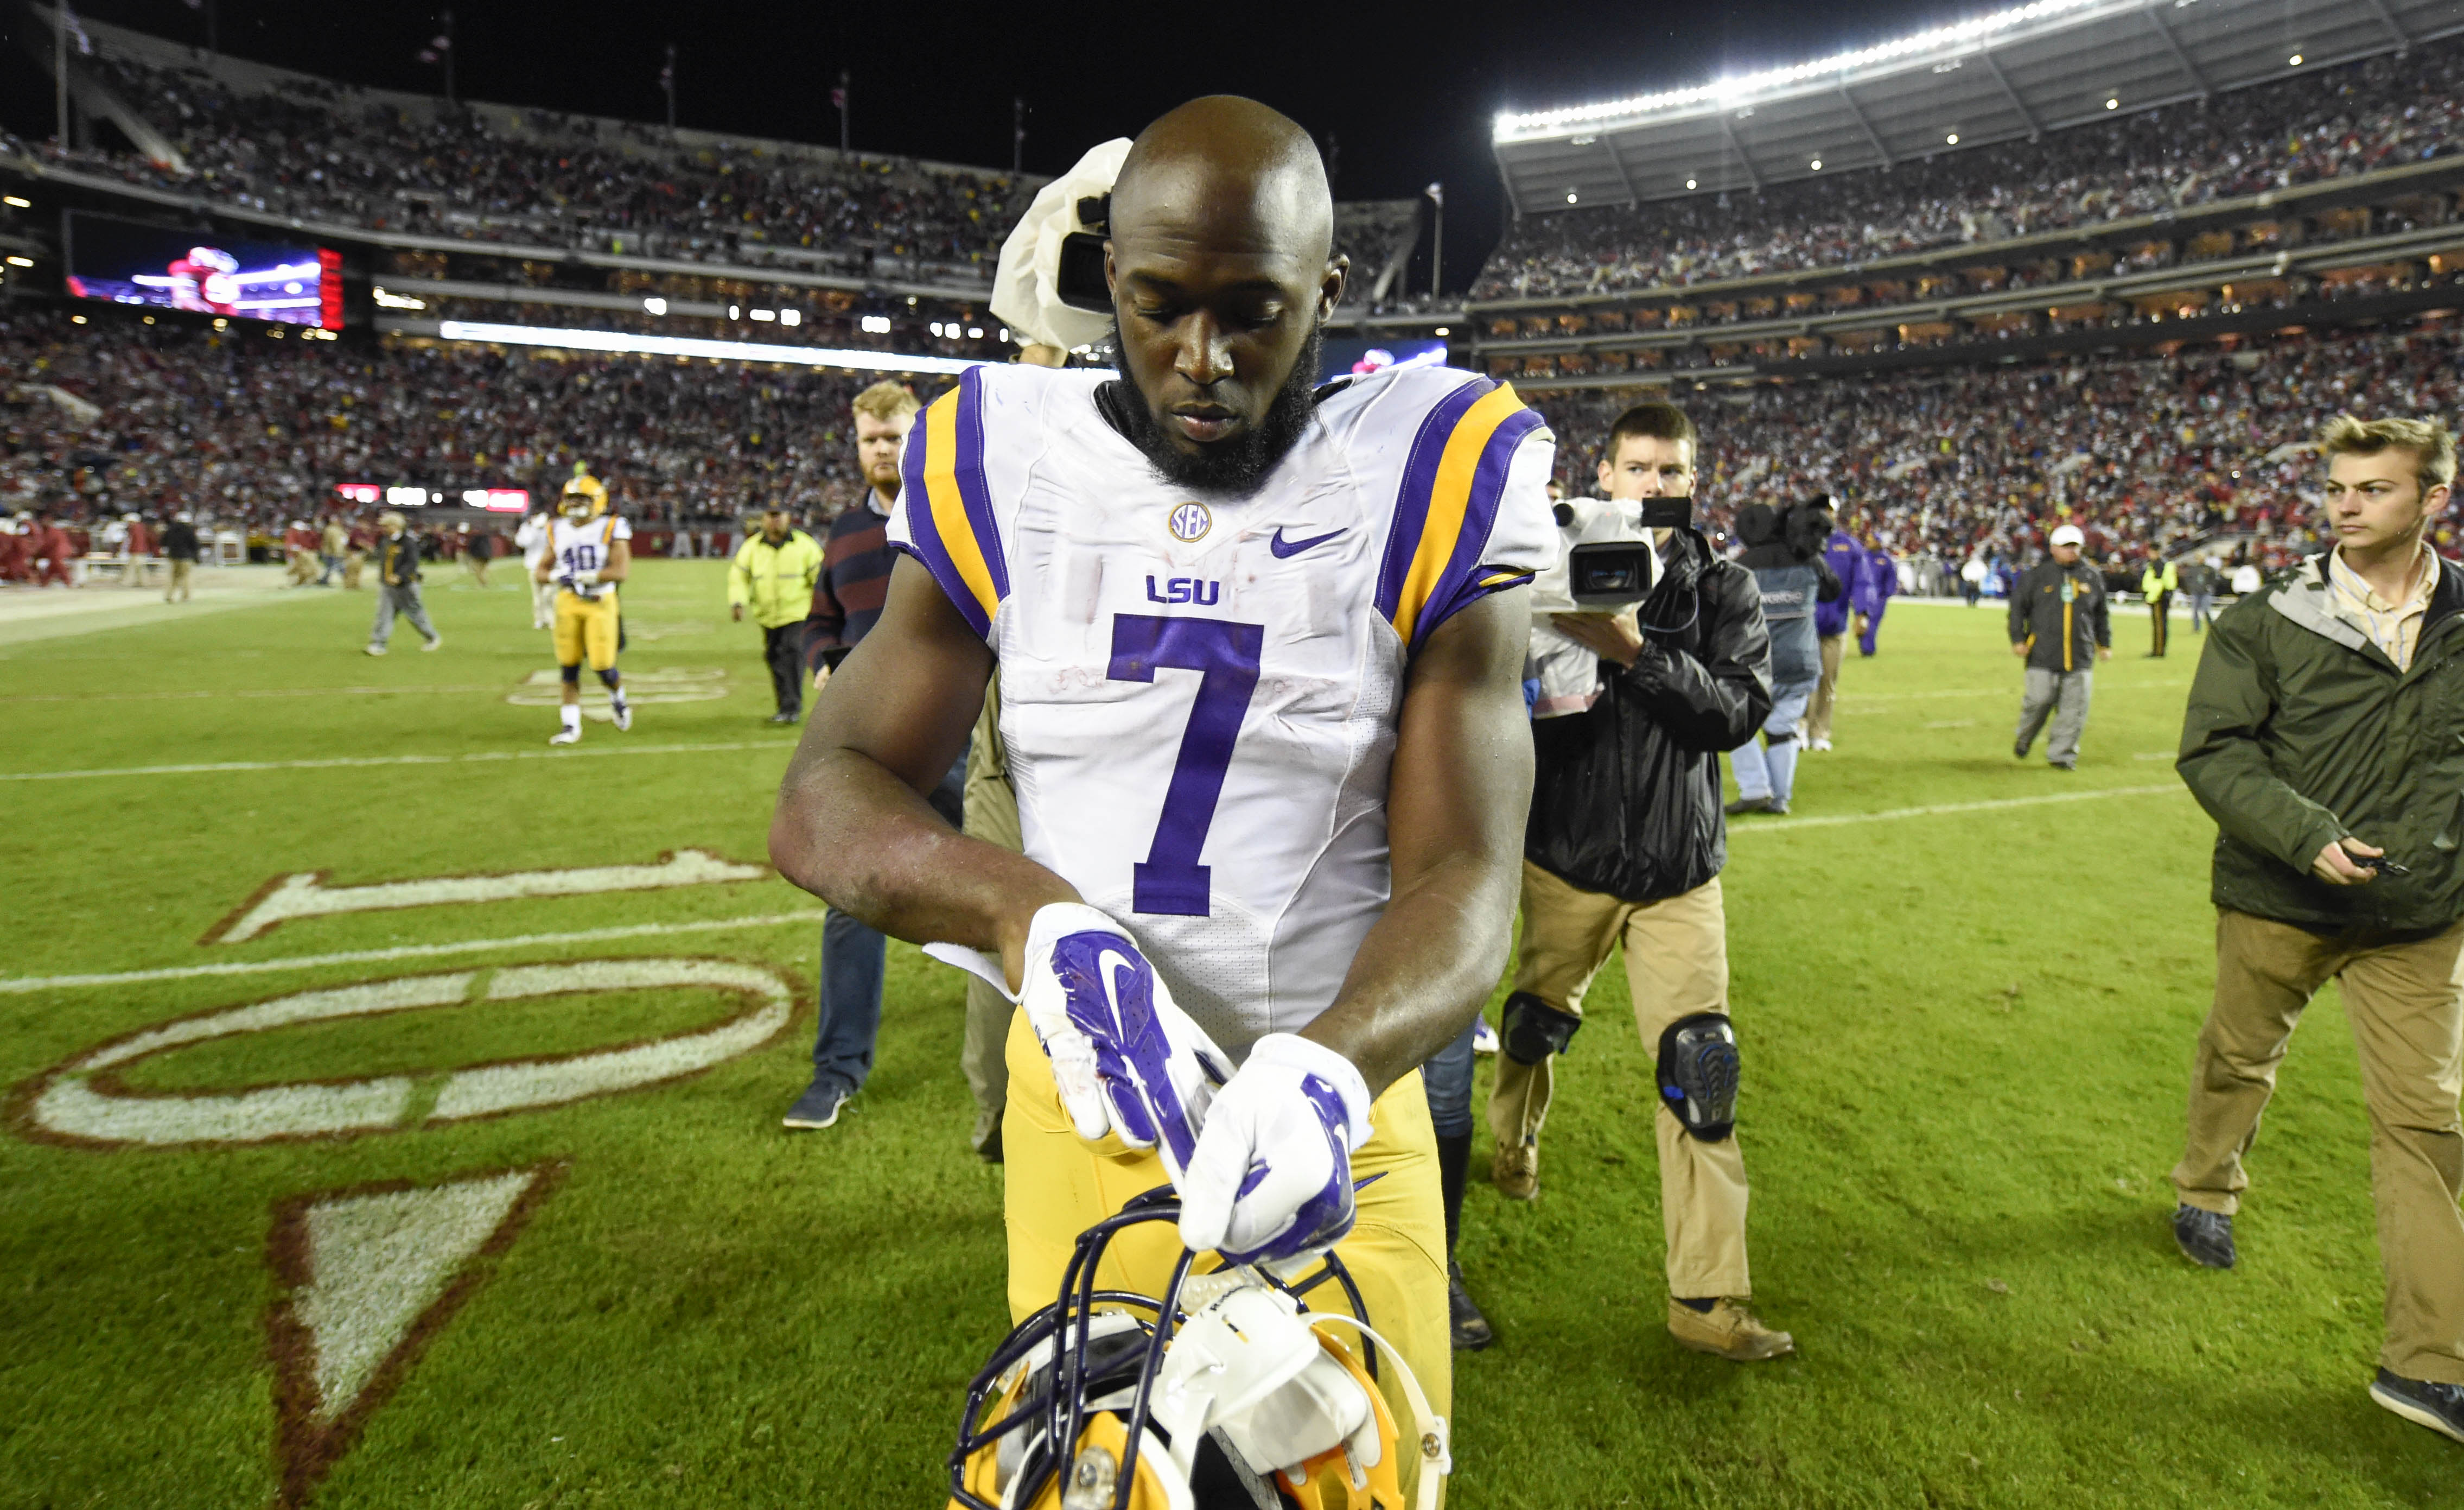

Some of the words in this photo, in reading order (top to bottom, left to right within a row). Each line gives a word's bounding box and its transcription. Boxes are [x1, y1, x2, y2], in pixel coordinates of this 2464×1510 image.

[1171, 504, 1209, 539] SEC
[1146, 575, 1220, 606] LSU
[1105, 613, 1265, 917] 7
